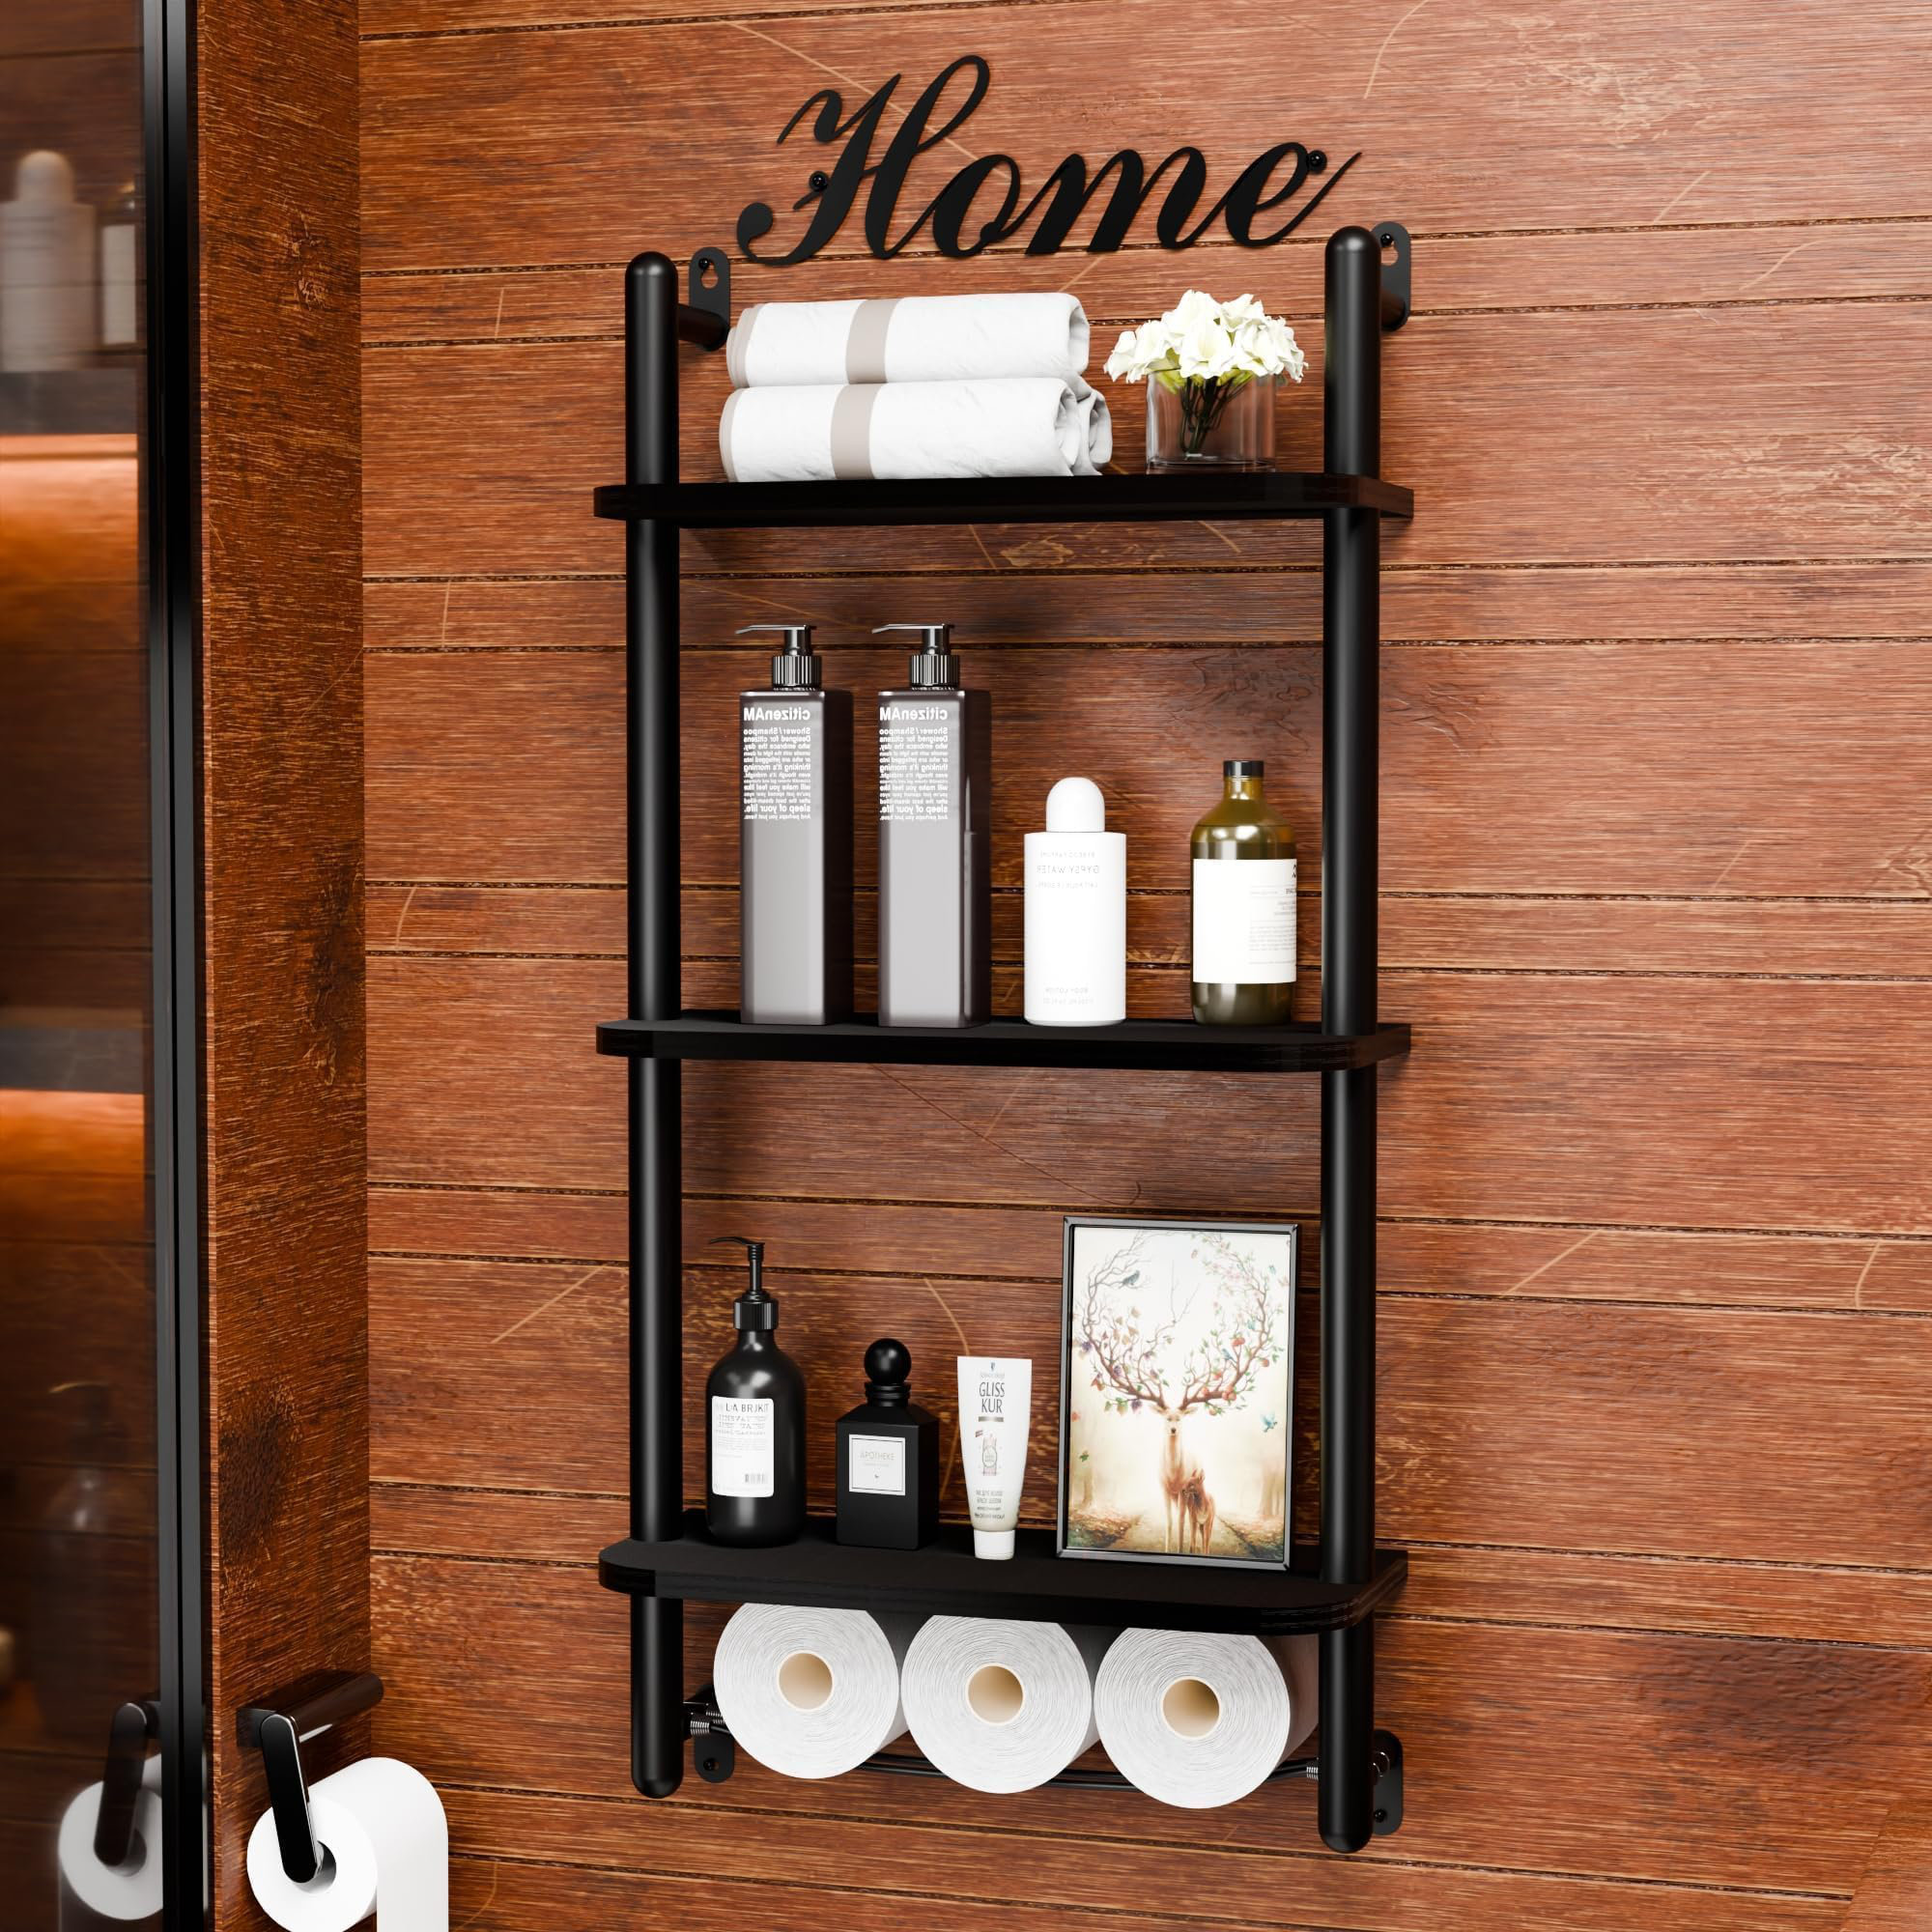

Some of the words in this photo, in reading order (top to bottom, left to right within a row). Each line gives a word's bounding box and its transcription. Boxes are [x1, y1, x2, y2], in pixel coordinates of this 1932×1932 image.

[736, 55, 1362, 266] Home
[980, 1381, 1006, 1398] GLISS
[981, 1399, 1003, 1413] KUR
